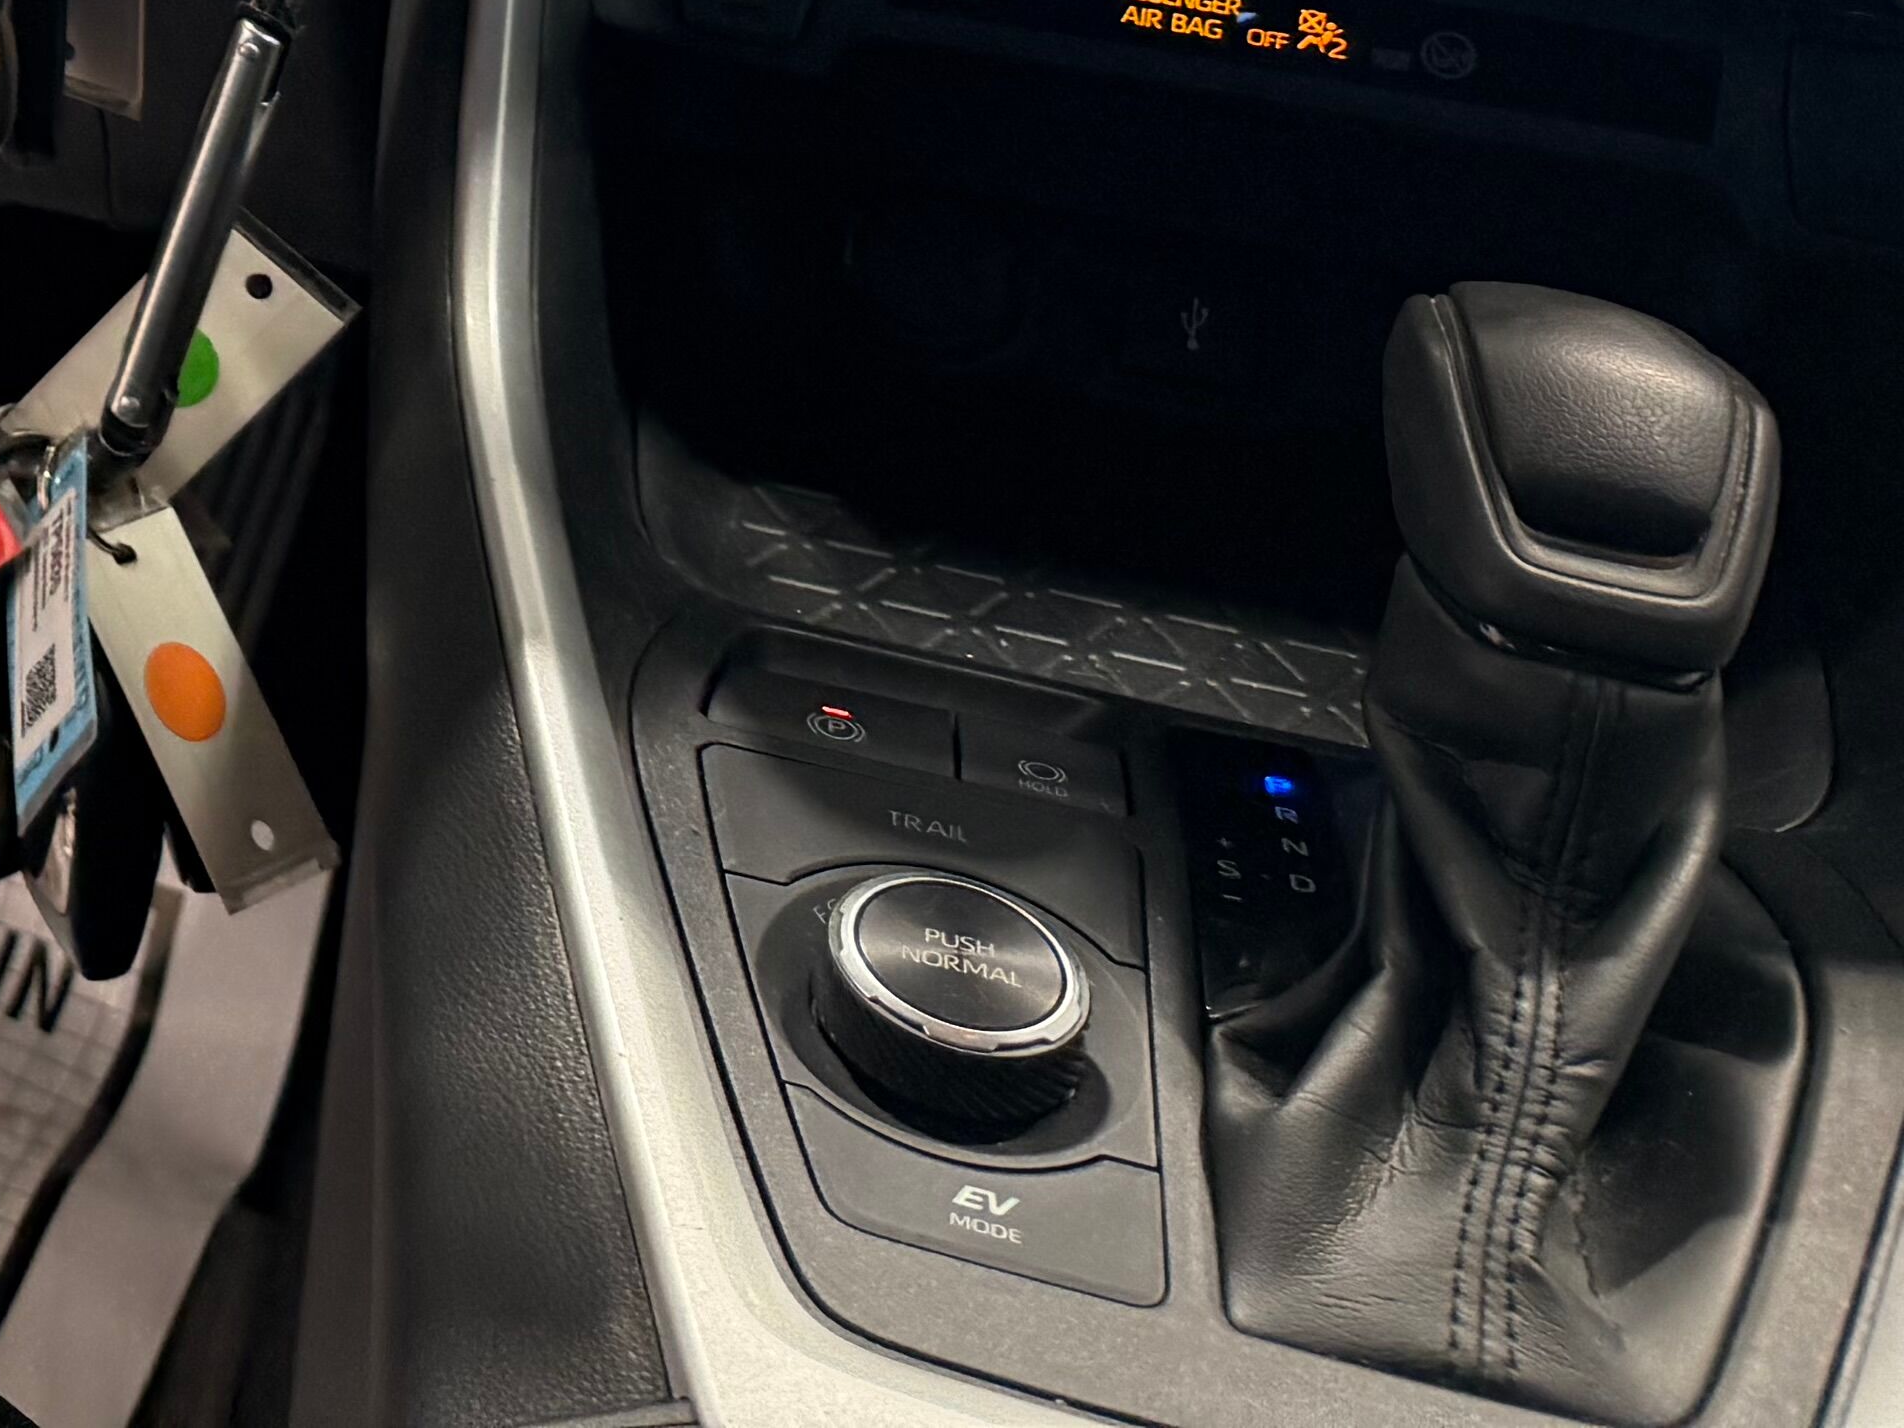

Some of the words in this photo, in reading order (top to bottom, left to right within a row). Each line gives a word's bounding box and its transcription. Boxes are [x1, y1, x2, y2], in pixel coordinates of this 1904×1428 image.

[1120, 4, 1163, 32] AIR
[1170, 12, 1224, 42] BAG
[1245, 27, 1292, 51] OFF
[1018, 777, 1070, 800] HOLD
[887, 808, 968, 843] TRAIL
[1280, 836, 1310, 857] N
[1216, 858, 1243, 880] S
[1288, 873, 1317, 894] D
[924, 927, 996, 958] PUSH
[901, 943, 1024, 989] NORMAL
[951, 1184, 1021, 1217] EV
[948, 1211, 1023, 1245] MODE
